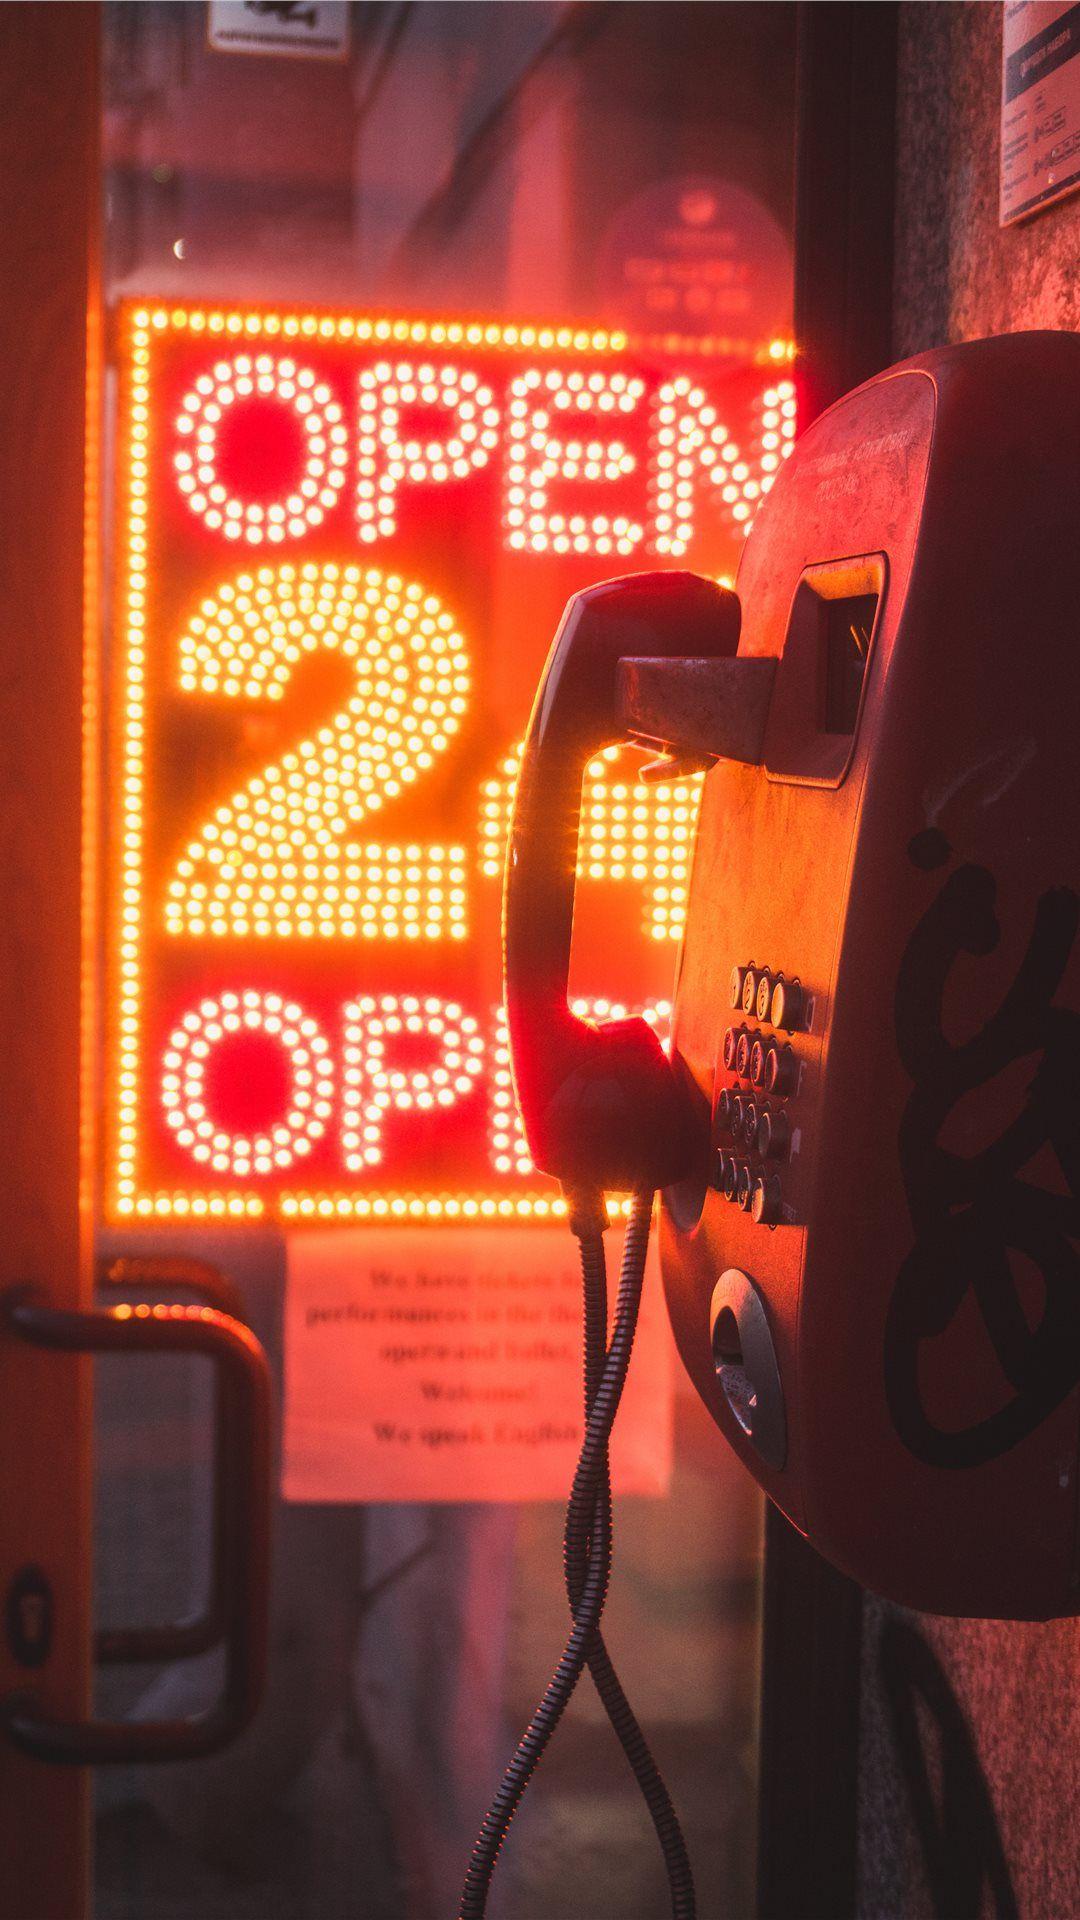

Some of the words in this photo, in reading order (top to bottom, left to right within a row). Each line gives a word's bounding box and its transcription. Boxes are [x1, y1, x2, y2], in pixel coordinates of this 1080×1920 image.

[172, 352, 797, 557] OPEN
[369, 1268, 408, 1288] We
[414, 1268, 470, 1288] have
[304, 1302, 470, 1329] performances
[454, 1341, 499, 1361] and
[373, 1421, 412, 1443] We
[419, 1422, 486, 1449] speak
